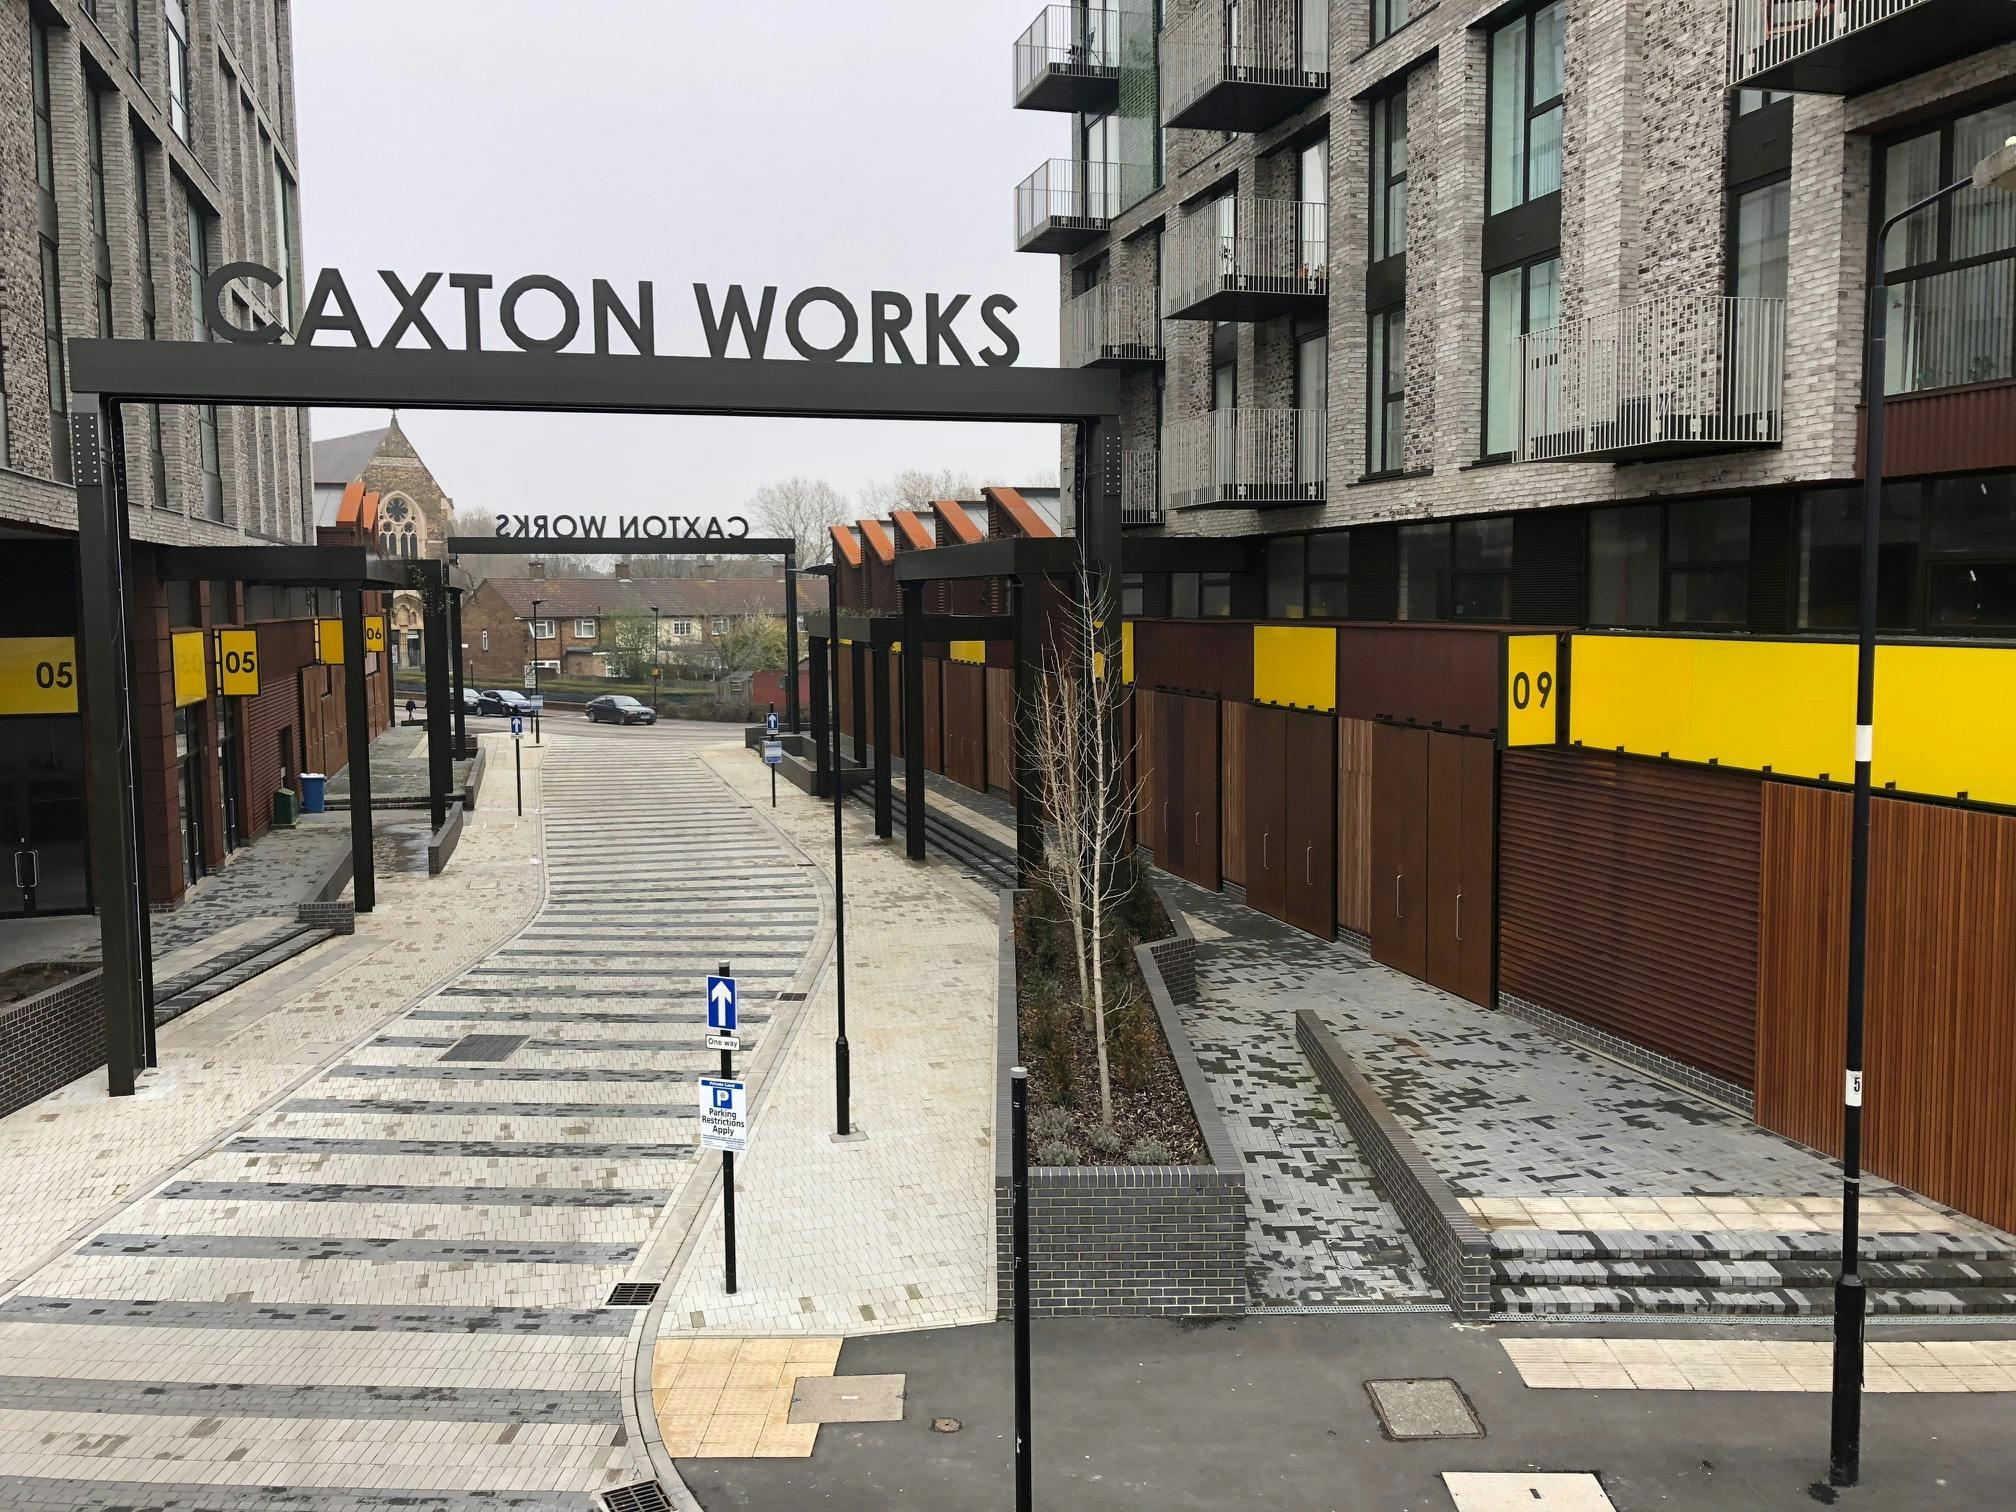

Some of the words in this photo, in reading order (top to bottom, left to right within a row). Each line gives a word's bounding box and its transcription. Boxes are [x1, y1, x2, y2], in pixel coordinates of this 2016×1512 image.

[204, 260, 655, 357] CAXTON
[693, 282, 1021, 368] WORKS
[366, 627, 382, 640] 06
[225, 650, 256, 674] 05
[36, 661, 73, 689] 05
[1513, 671, 1553, 710] 09
[708, 1037, 722, 1046] One
[1853, 1077, 1860, 1092] 5
[717, 1089, 729, 1106] P
[702, 1115, 745, 1128] Restrictions
[709, 1108, 736, 1120] Parking
[712, 1125, 735, 1136] Apply
